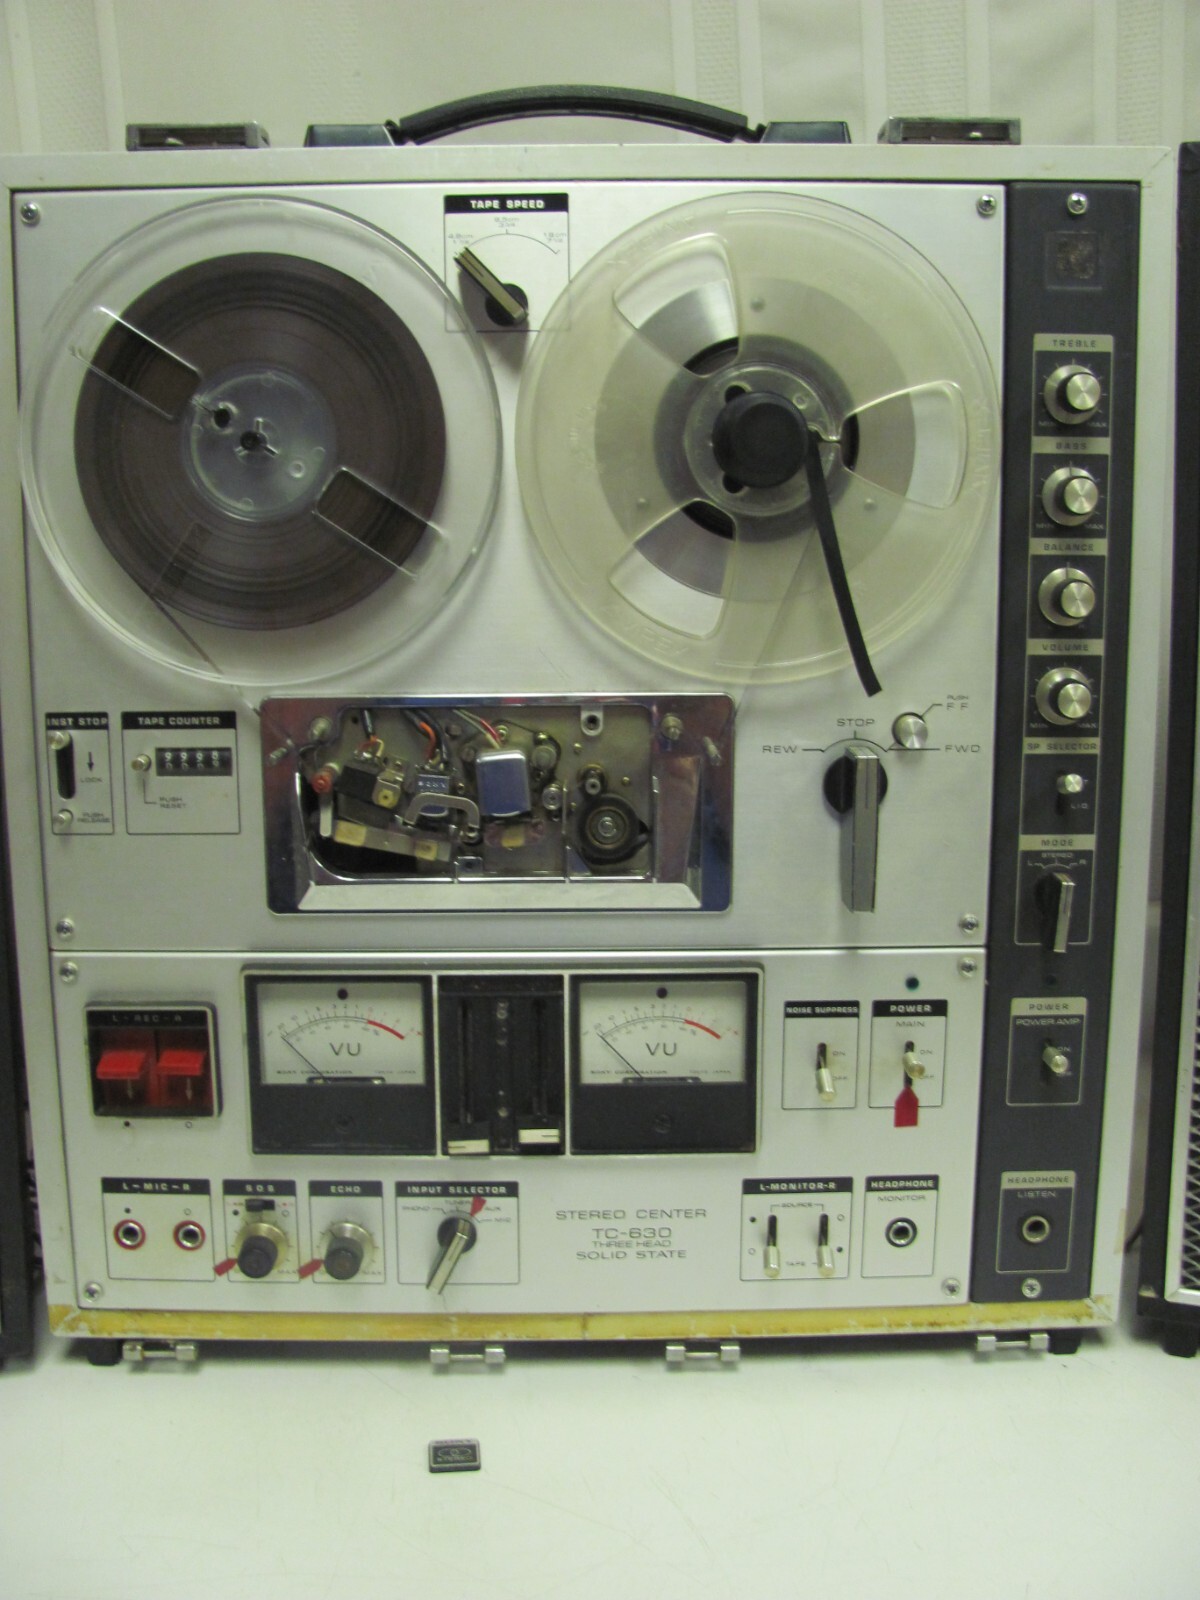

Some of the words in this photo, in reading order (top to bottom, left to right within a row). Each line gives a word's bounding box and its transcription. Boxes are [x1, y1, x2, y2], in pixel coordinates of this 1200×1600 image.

[470, 200, 500, 209] TAPE
[506, 200, 545, 209] SPEED
[1052, 339, 1097, 348] TREBLE
[1056, 442, 1088, 450] BASS
[1043, 543, 1094, 551] BALANCE
[1042, 643, 1089, 651] VOLUME
[47, 718, 74, 726] INST
[78, 718, 108, 726] STOP
[138, 717, 165, 725] TAPE
[169, 717, 220, 725] COUNTER
[836, 718, 875, 727] STOP
[762, 745, 798, 754] REW
[945, 744, 981, 753] FWD
[1041, 839, 1073, 847] MODE
[786, 1006, 813, 1014] NOISE
[890, 1004, 932, 1012] POWER
[1029, 1003, 1069, 1011] POWER
[1016, 1018, 1054, 1026] POWER
[329, 1042, 361, 1056] VU
[645, 1042, 678, 1056] VU
[871, 1180, 934, 1188] HEADPHONE
[1008, 1176, 1069, 1184] HEADPHONE
[407, 1186, 442, 1194] INPUT
[449, 1186, 507, 1194] SELECTOR
[1017, 1190, 1057, 1198] LISTEN
[555, 1209, 627, 1220] STEREO
[635, 1208, 707, 1219] CENTER
[592, 1227, 672, 1239] TC-630
[592, 1240, 633, 1248] THREE
[636, 1240, 672, 1248] HEAD
[576, 1250, 627, 1260] SOLID
[636, 1249, 688, 1259] STATE
